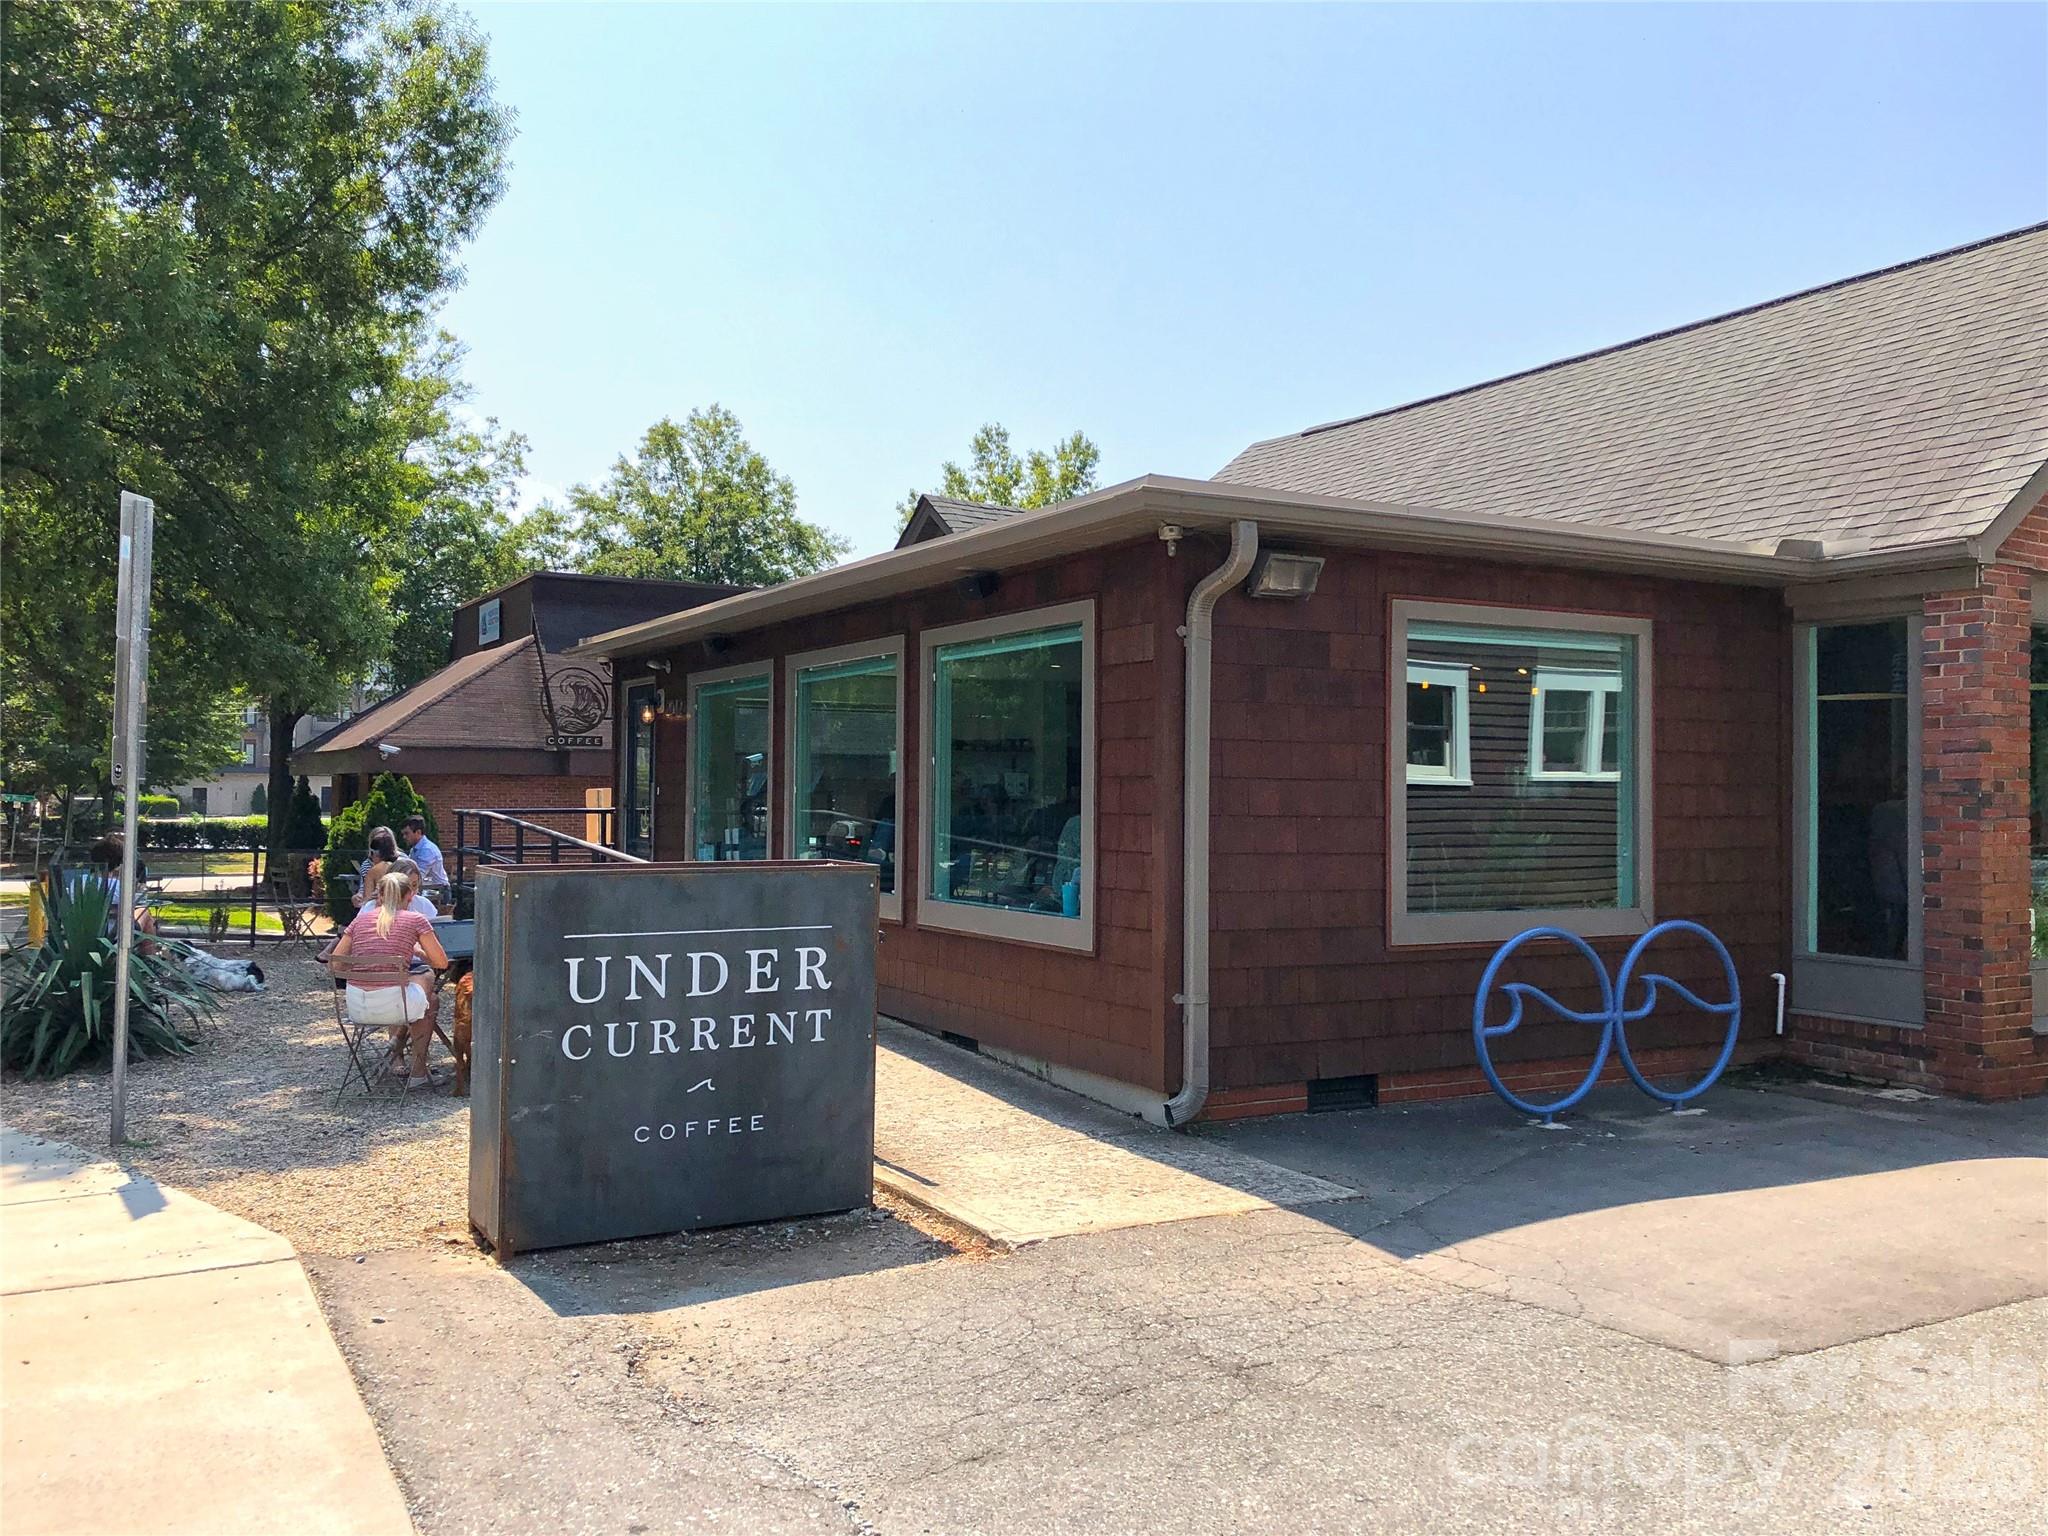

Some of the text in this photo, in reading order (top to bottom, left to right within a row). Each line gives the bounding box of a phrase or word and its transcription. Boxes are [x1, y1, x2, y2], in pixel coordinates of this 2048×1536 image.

[547, 737, 601, 745] COFFEE
[563, 946, 833, 1004] UNDER
[561, 1008, 832, 1061] CURRENT
[634, 1114, 765, 1143] COFFEE
